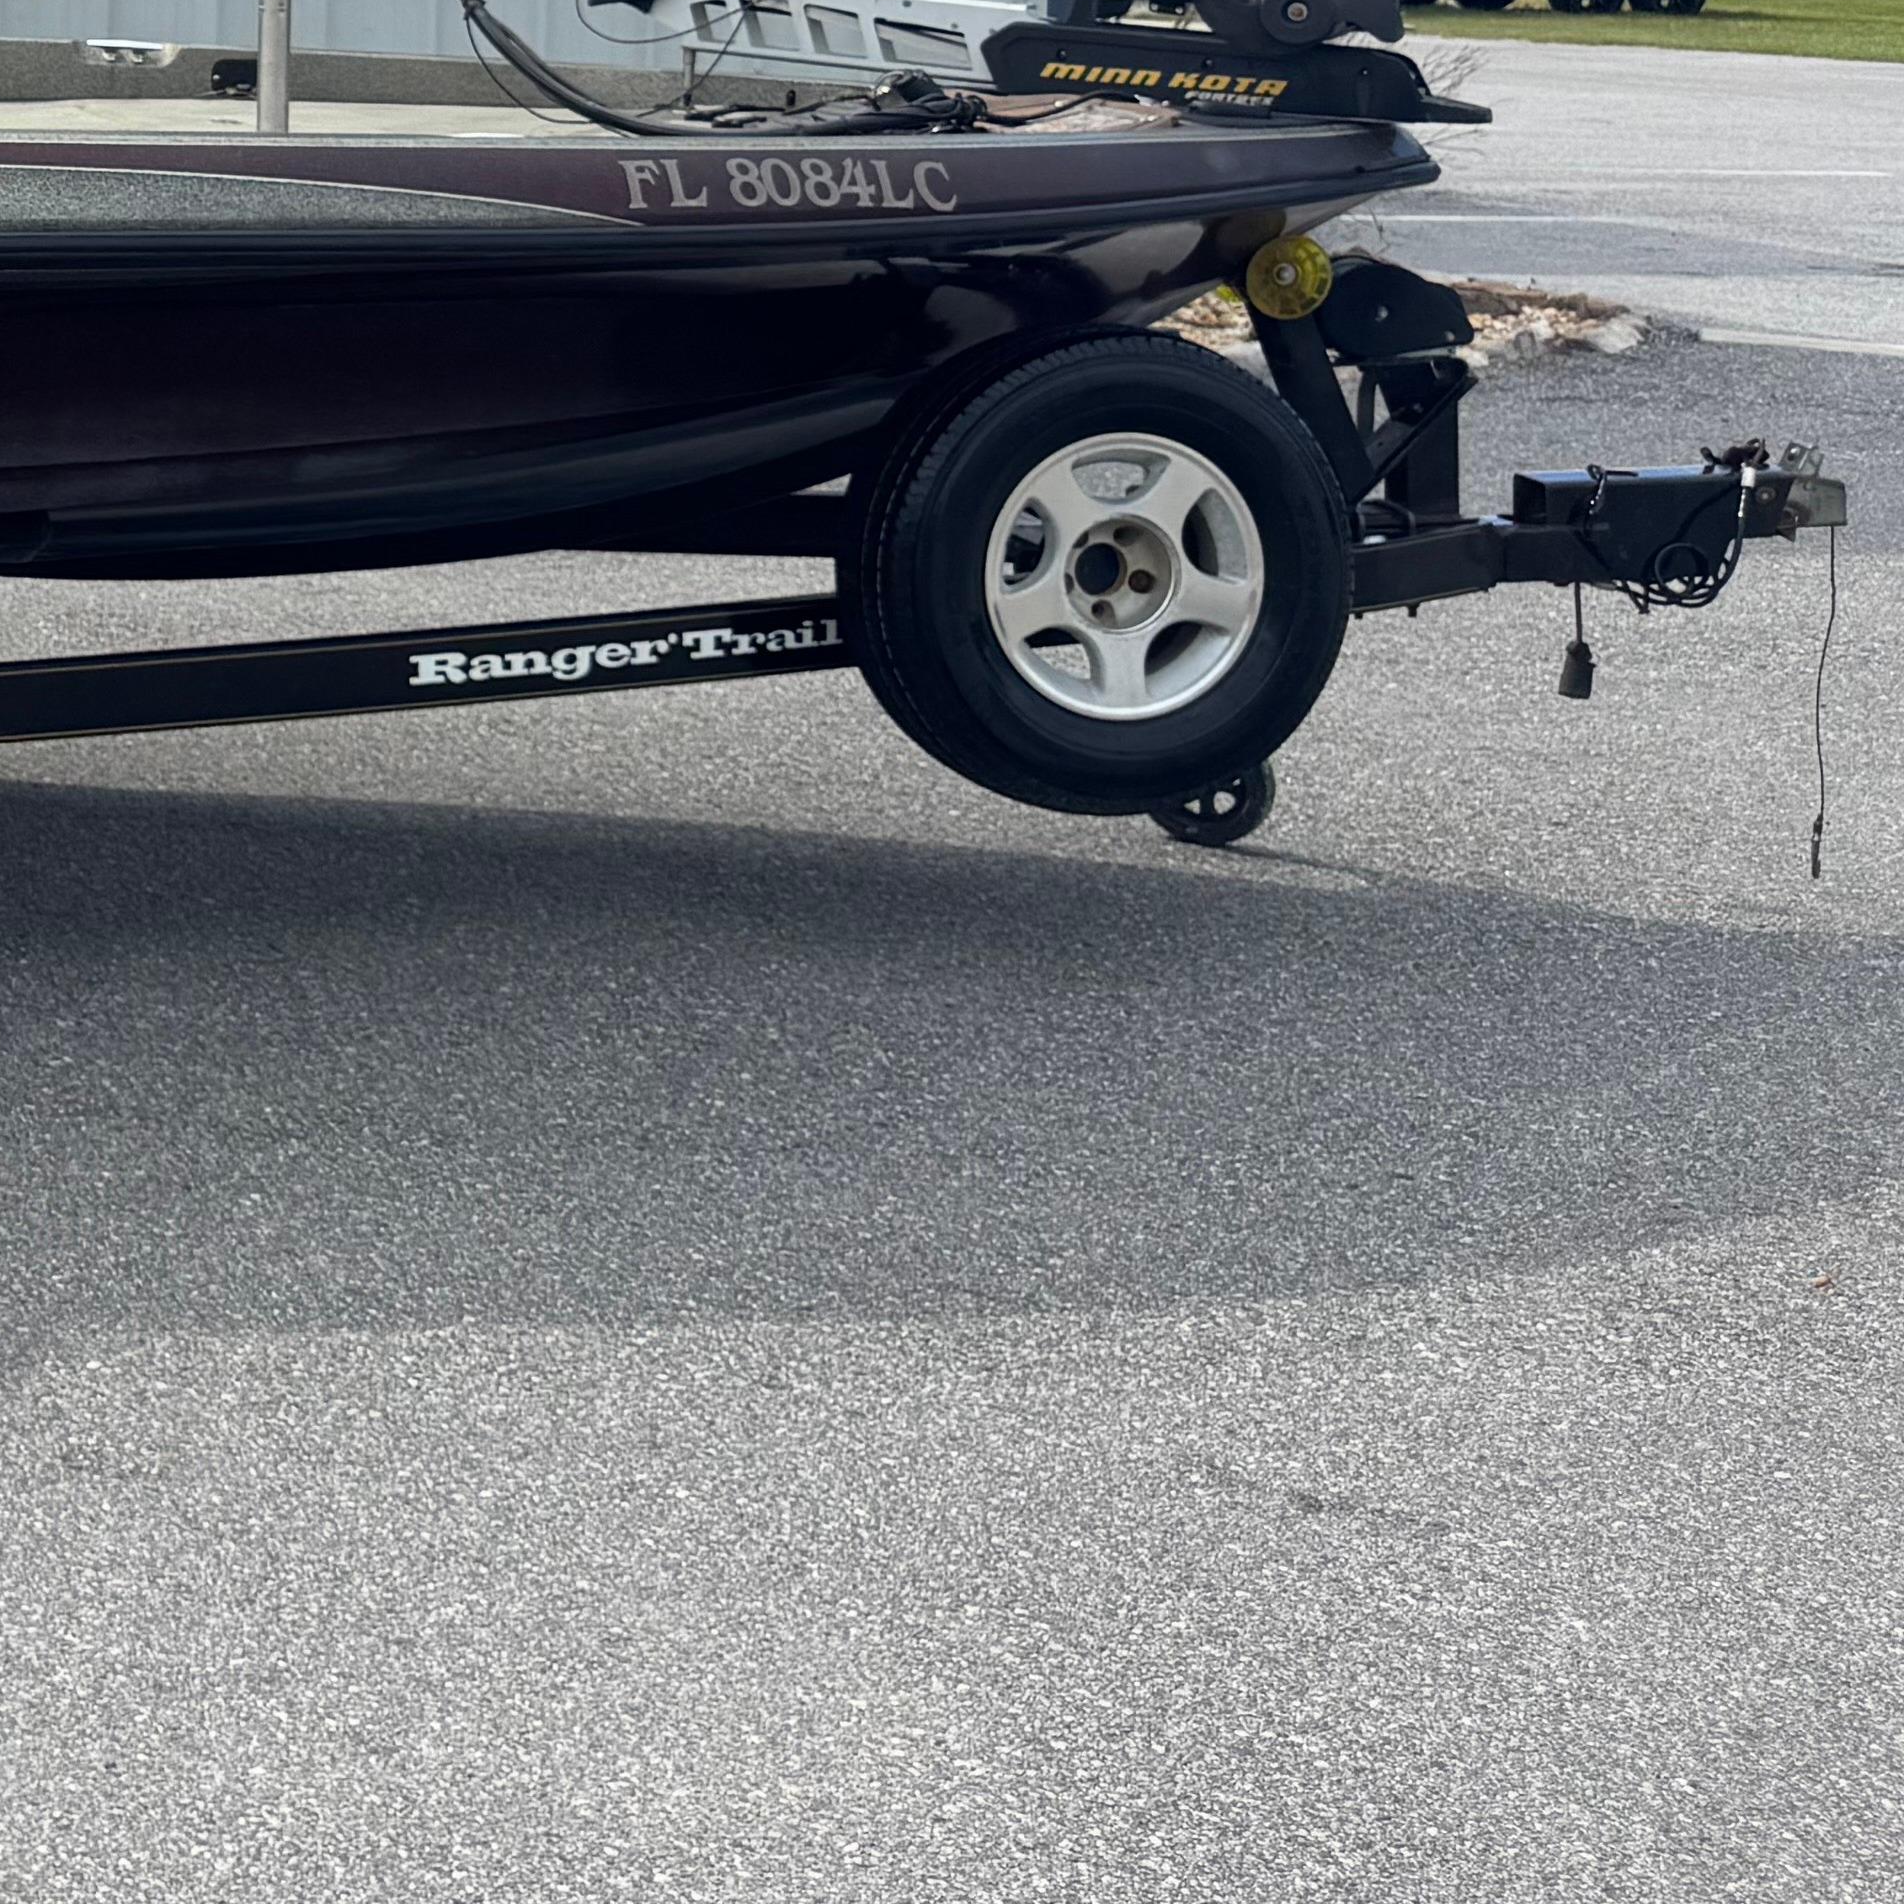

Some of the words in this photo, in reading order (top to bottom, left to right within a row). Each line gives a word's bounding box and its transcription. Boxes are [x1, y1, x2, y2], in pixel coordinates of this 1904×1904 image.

[1167, 71, 1289, 96] KOTA
[617, 158, 708, 210] FL
[725, 156, 958, 212] 8084LC
